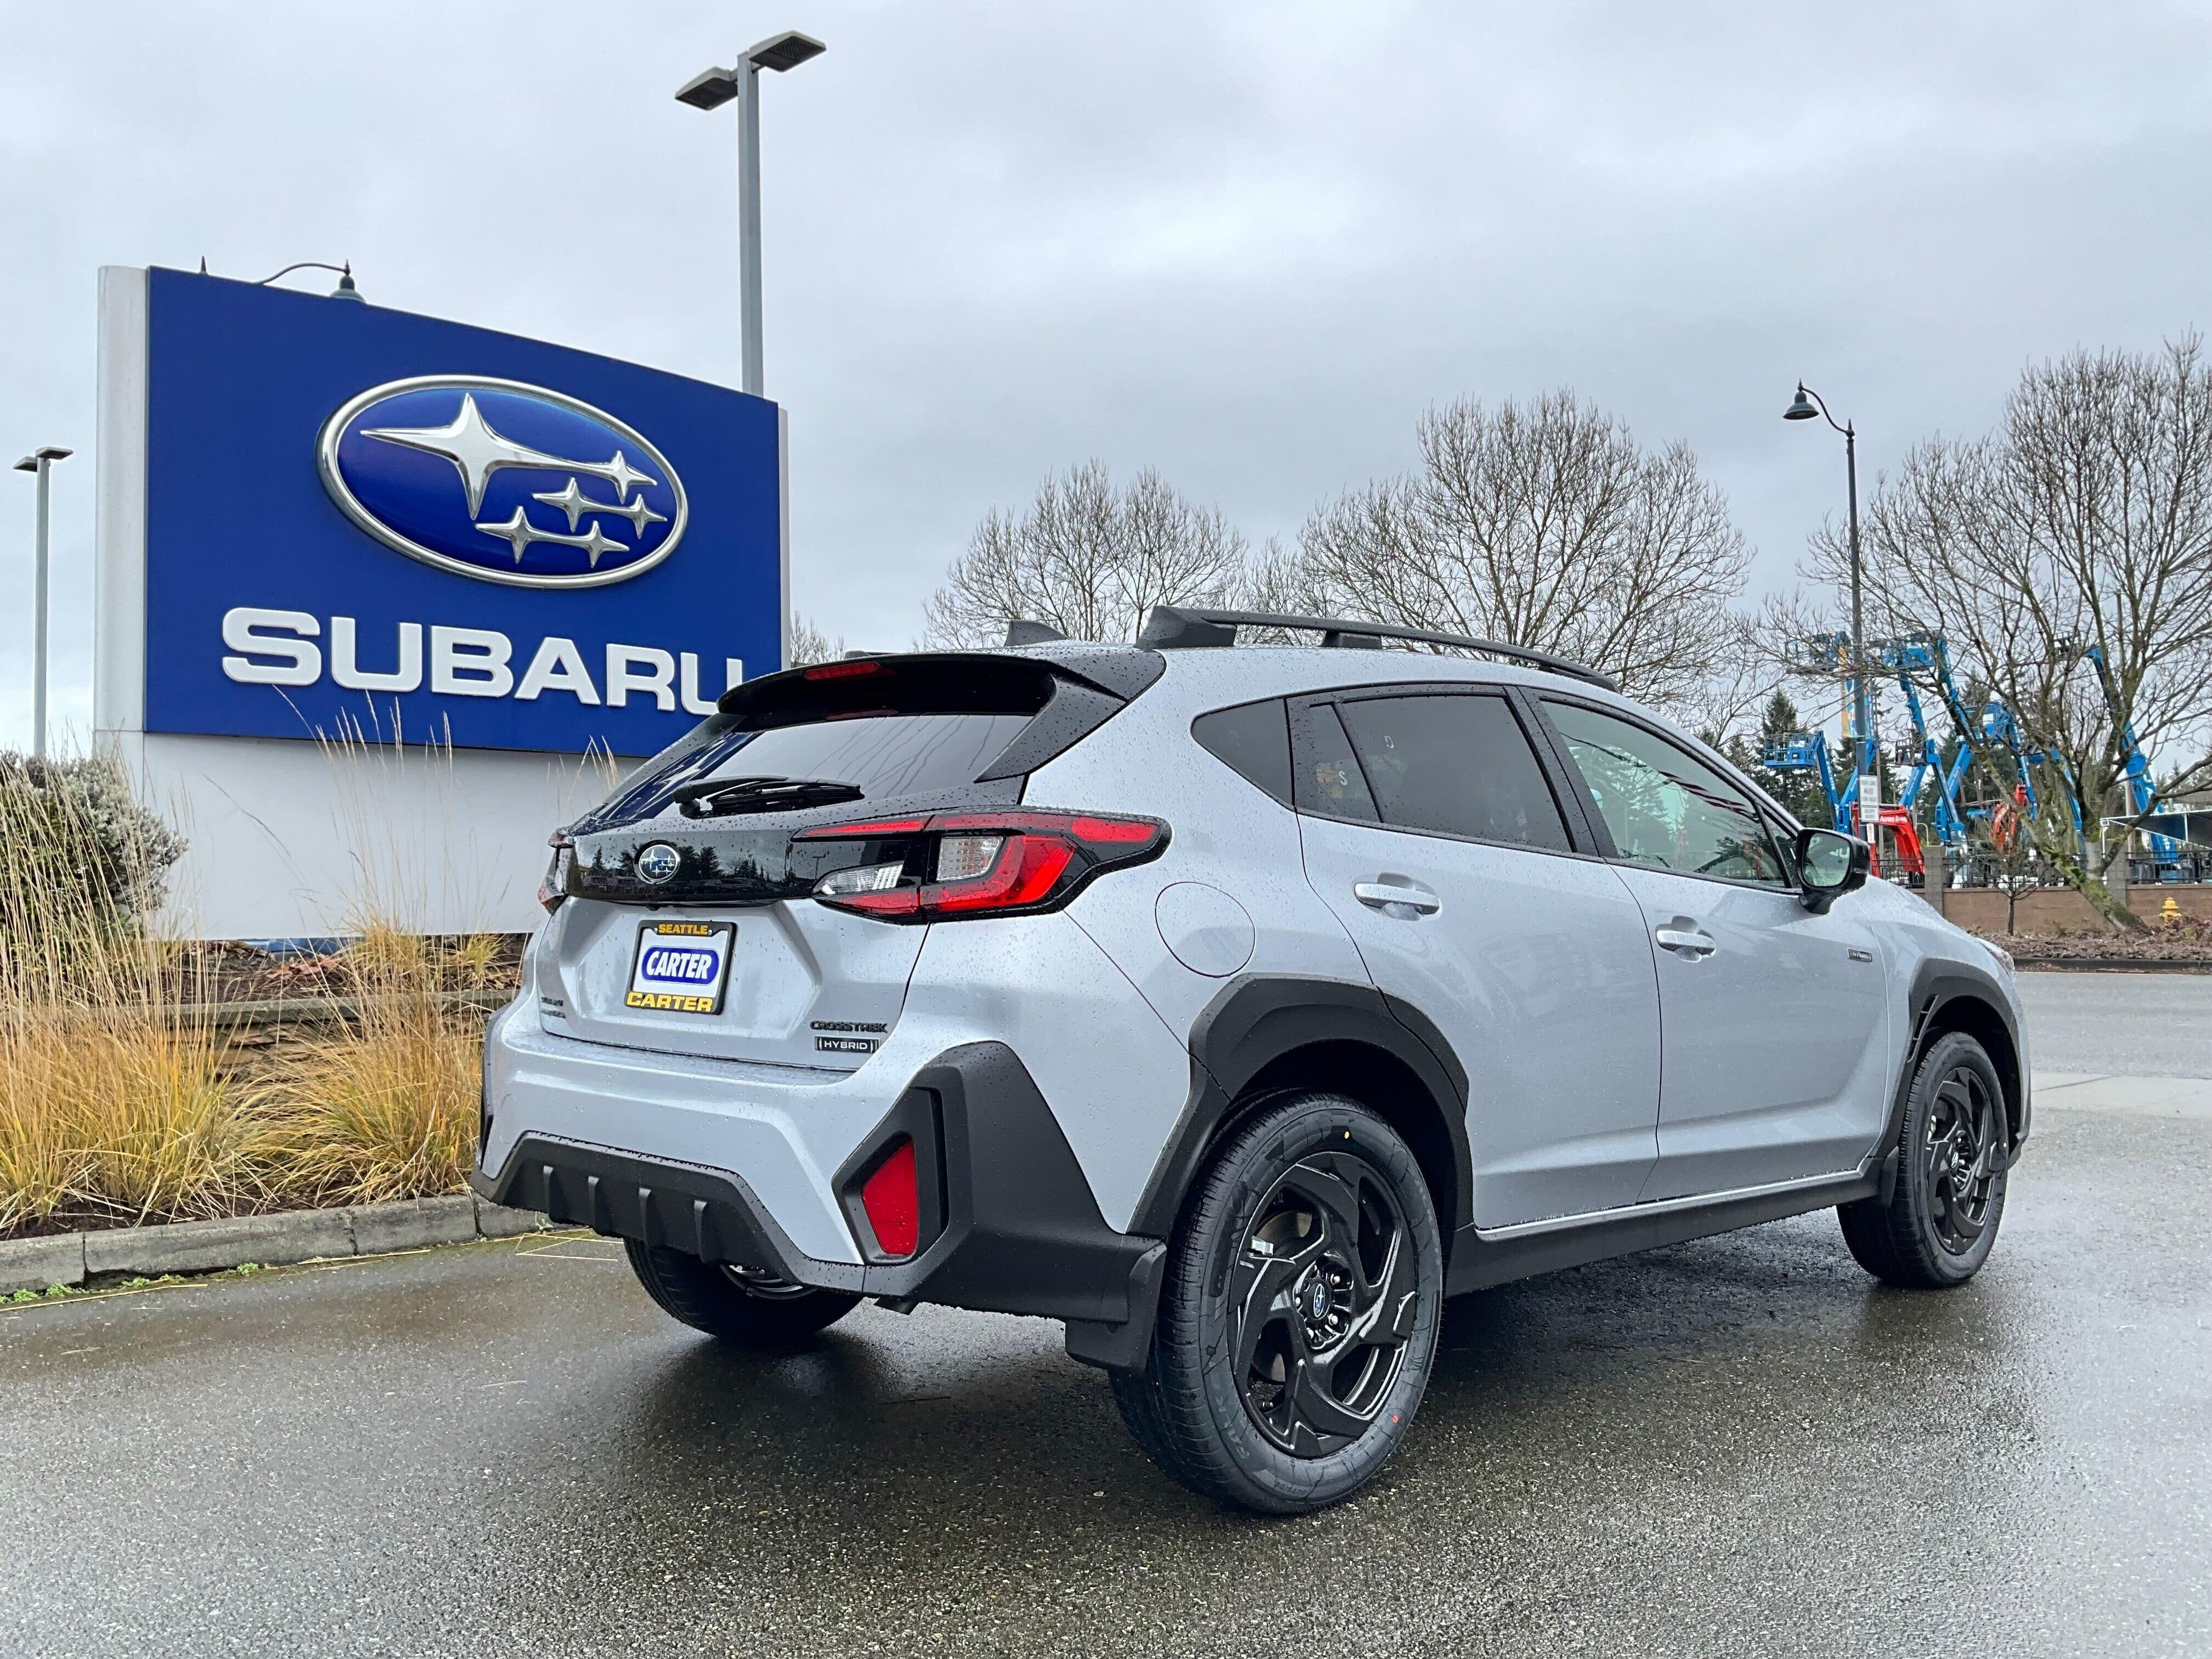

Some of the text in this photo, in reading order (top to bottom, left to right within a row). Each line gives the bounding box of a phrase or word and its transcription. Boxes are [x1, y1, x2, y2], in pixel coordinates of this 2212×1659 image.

[222, 607, 743, 716] SUBARU
[658, 924, 708, 935] SEATTLE
[646, 951, 712, 979] CARTER
[627, 992, 713, 1012] CARTER
[810, 1020, 888, 1034] CROSSTREK
[824, 1040, 868, 1049] HYBRID
